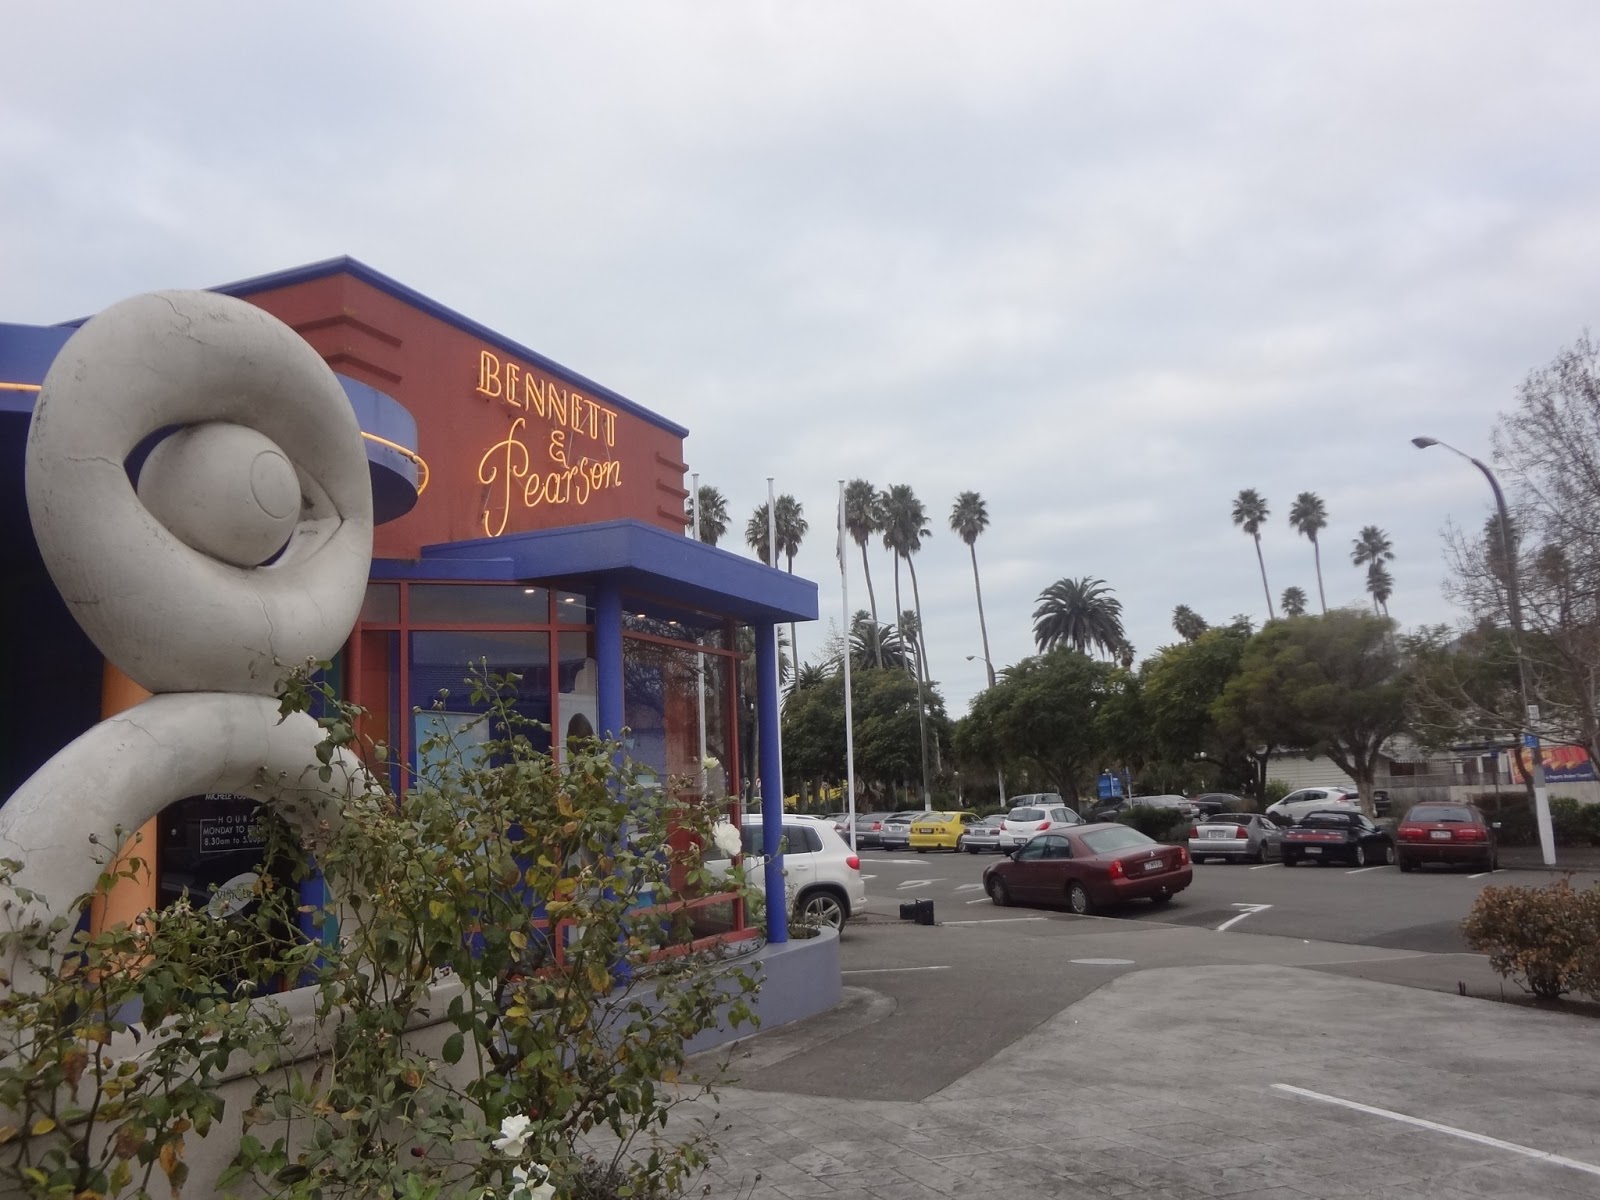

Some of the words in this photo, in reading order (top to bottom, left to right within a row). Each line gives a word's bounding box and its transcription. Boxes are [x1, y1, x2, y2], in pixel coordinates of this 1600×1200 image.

[476, 350, 617, 447] BENNETT
[549, 430, 570, 468] &
[478, 417, 622, 537] Pearson
[203, 826, 234, 835] MONDAY
[235, 825, 245, 834] TO
[218, 815, 255, 824] HOURS
[204, 837, 231, 846] 8.30am
[233, 837, 240, 845] to
